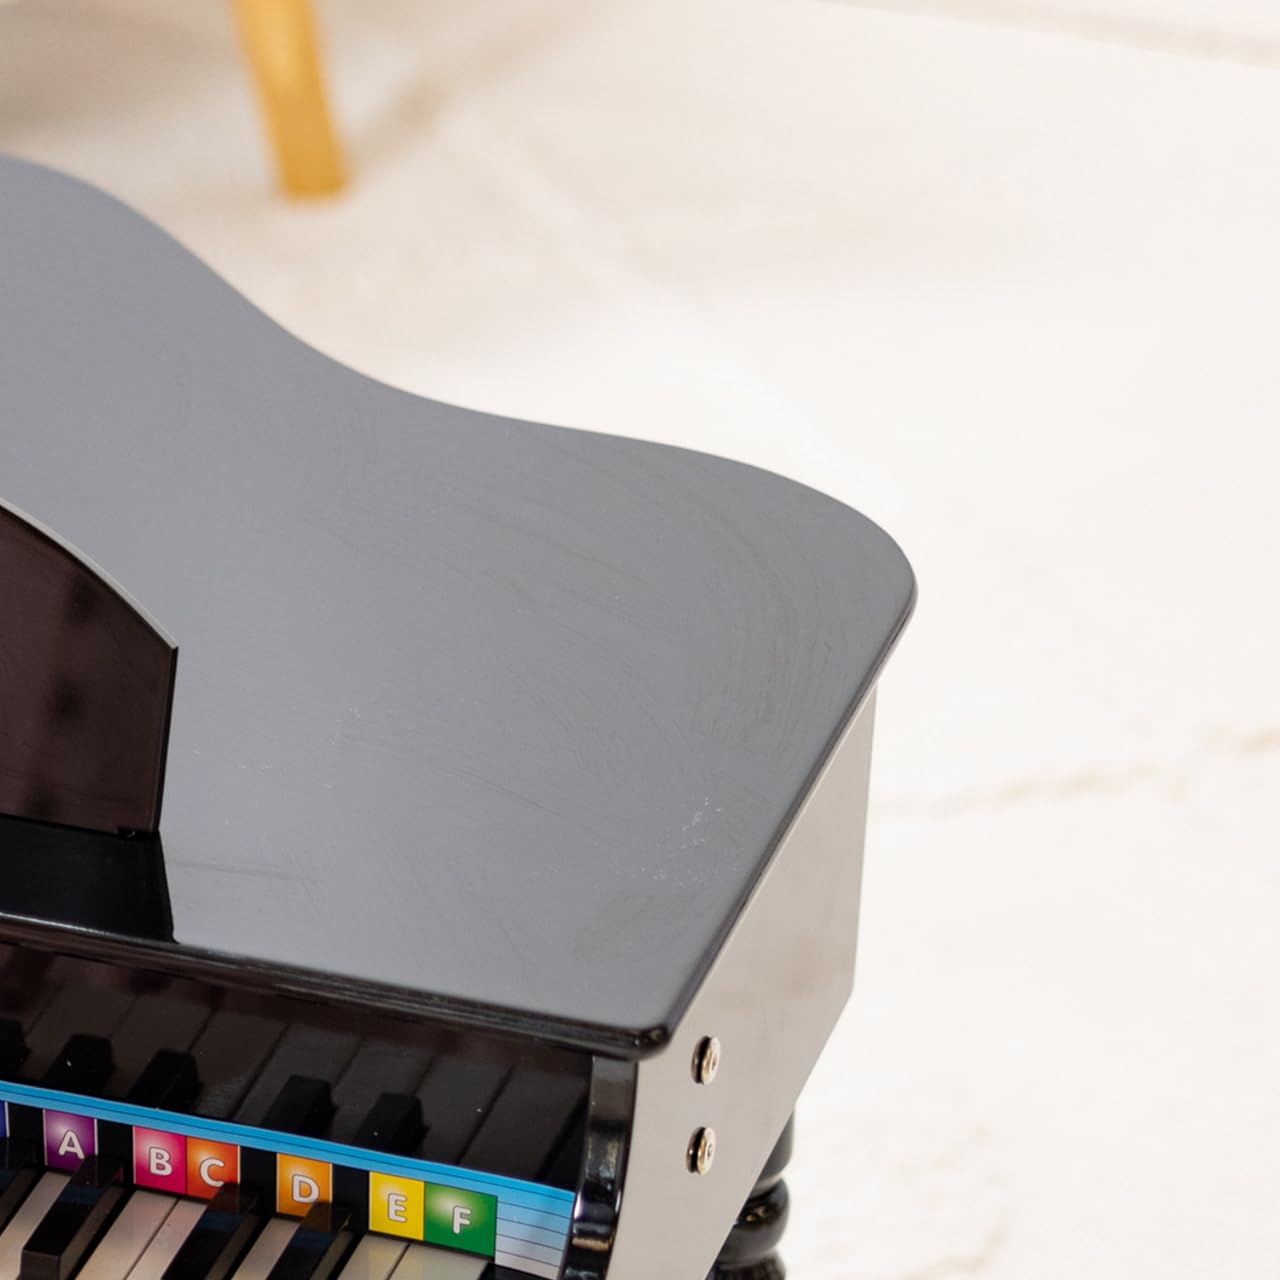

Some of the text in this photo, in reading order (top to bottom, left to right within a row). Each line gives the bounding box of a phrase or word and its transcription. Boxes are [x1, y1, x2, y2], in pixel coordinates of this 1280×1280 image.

[57, 1129, 85, 1160] A
[147, 1145, 174, 1177] B
[198, 1157, 226, 1188] C
[291, 1173, 320, 1204] D
[386, 1191, 408, 1223] E
[450, 1204, 472, 1235] F
